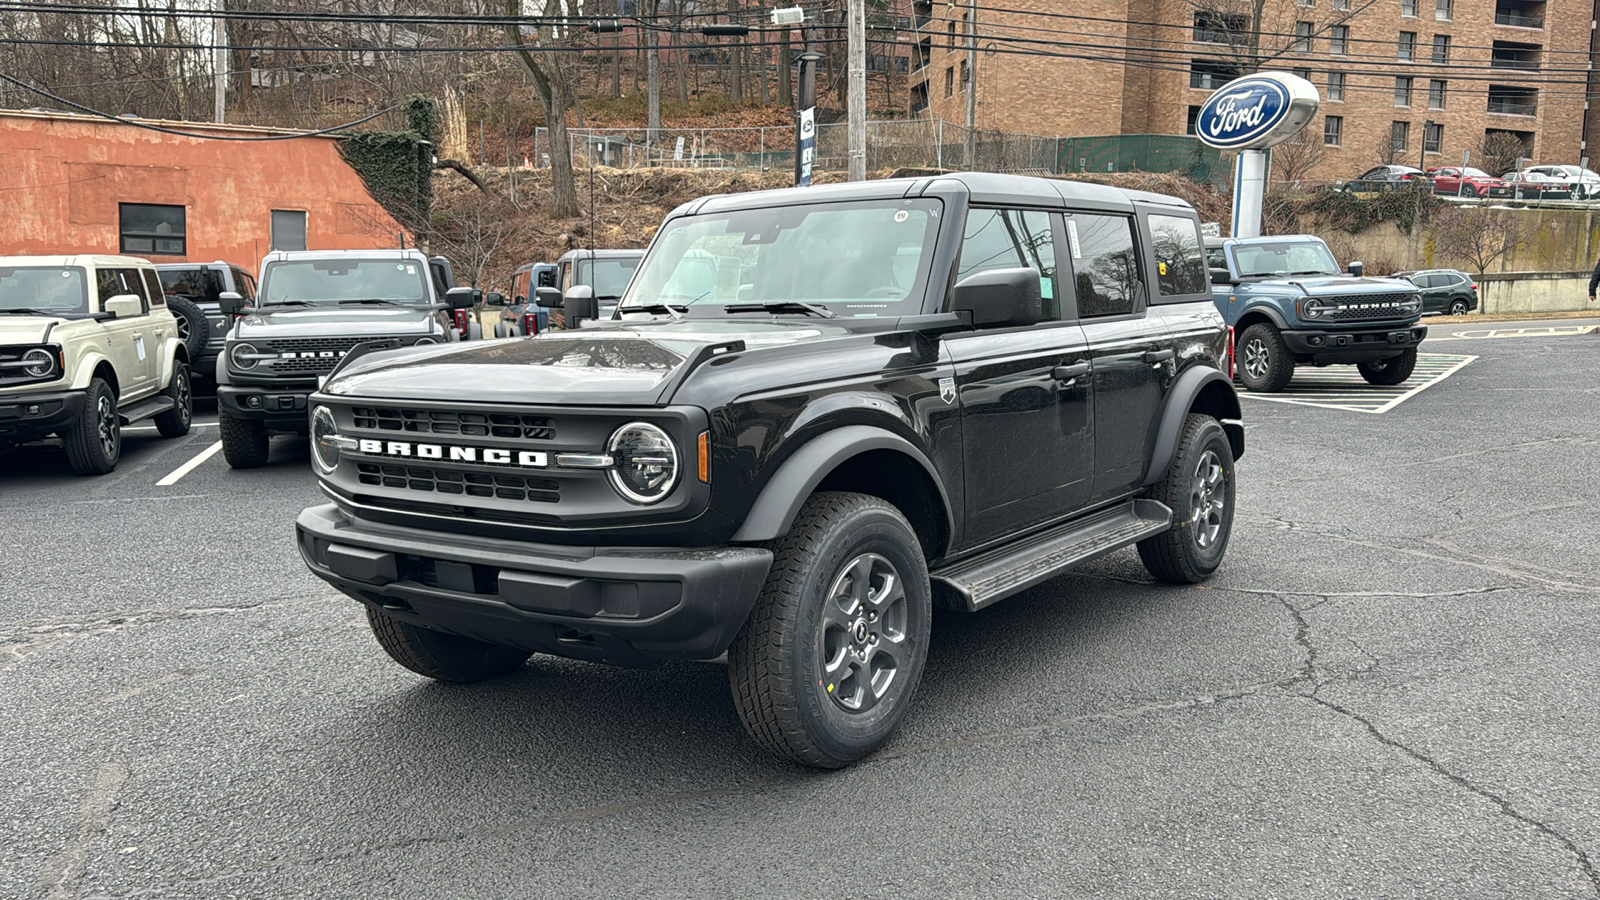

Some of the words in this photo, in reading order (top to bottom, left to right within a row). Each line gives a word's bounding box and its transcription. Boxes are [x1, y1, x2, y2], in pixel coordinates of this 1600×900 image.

[1210, 89, 1267, 136] Ford
[1338, 302, 1400, 310] BRONCO
[281, 351, 348, 359] BRON
[359, 439, 548, 467] BRONCO
